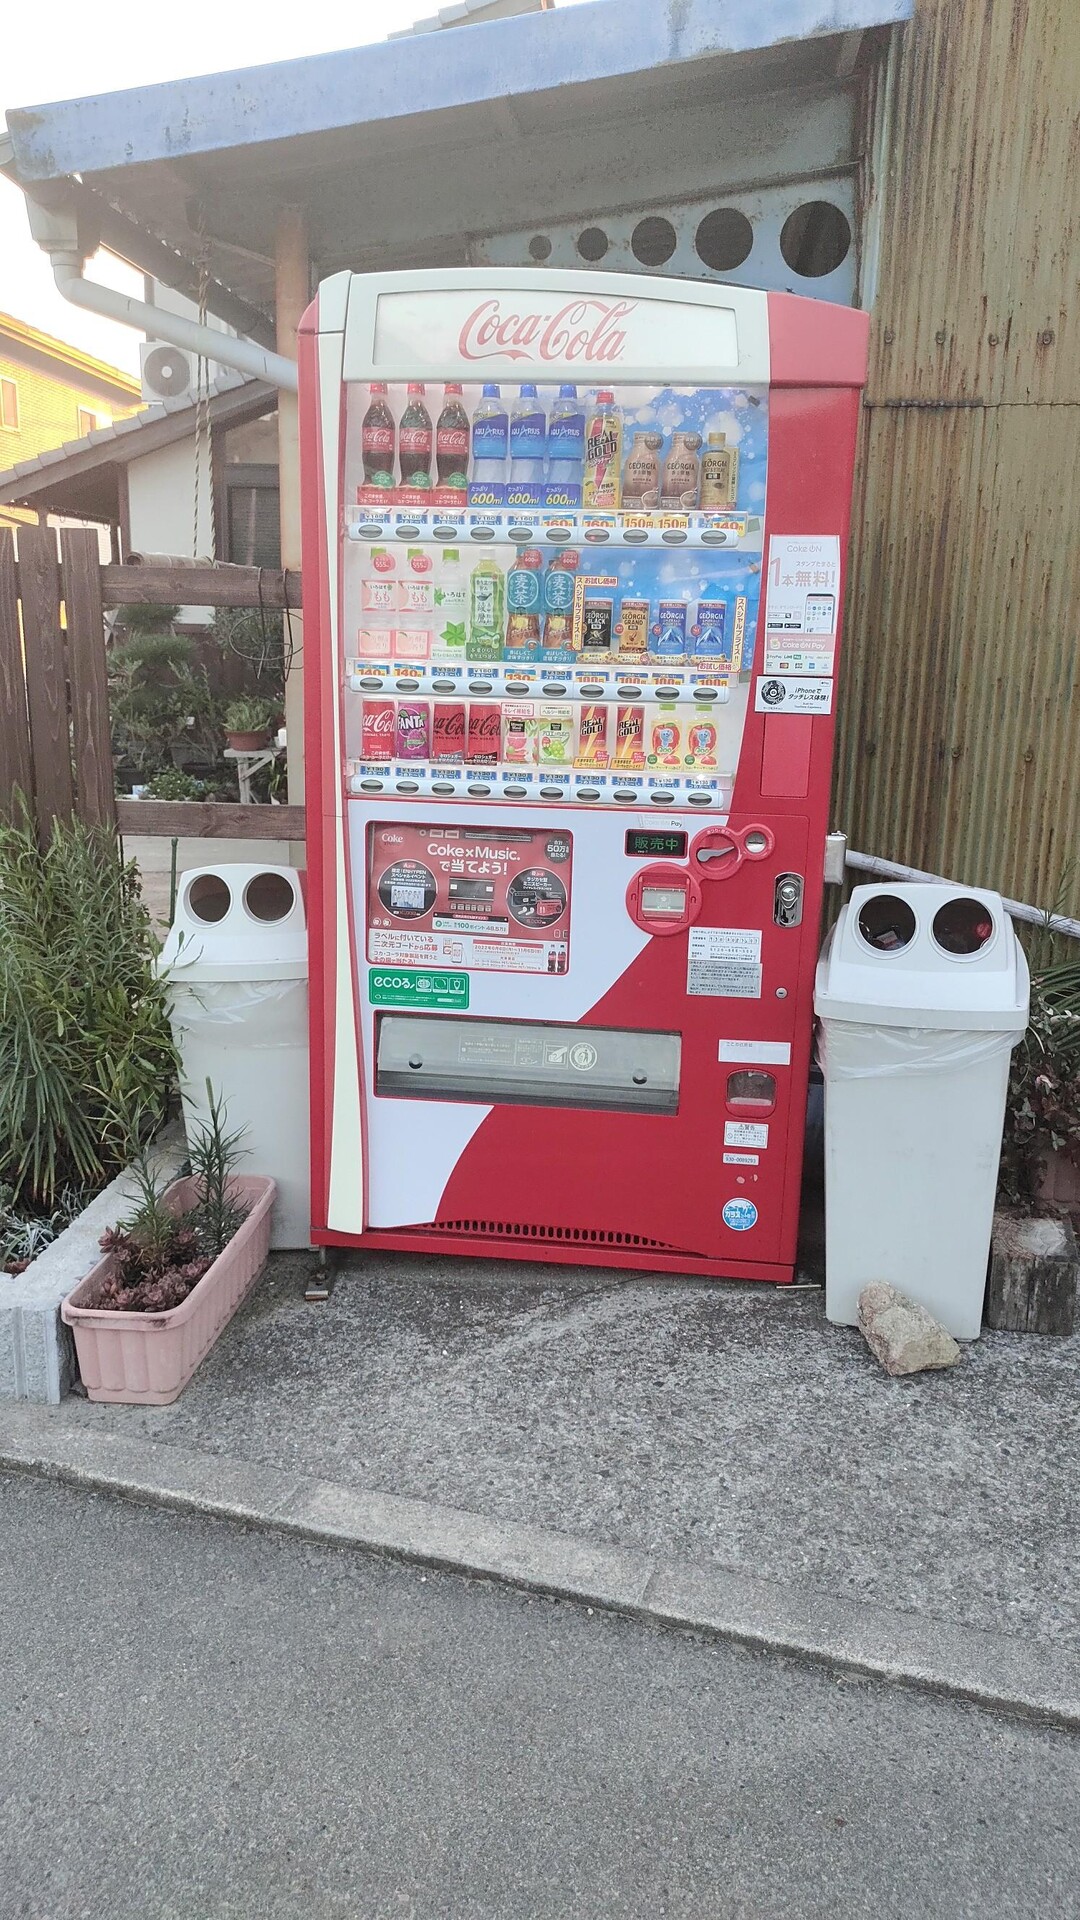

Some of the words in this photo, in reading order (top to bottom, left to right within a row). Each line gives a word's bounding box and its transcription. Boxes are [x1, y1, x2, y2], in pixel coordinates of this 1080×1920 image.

[458, 299, 638, 362] Coca-Cola
[474, 424, 505, 439] AQUARIUS
[511, 425, 540, 439] AQUARIUS
[550, 425, 580, 440] AQUARIUS
[588, 431, 616, 450] REAL
[587, 442, 617, 460] GOLD
[629, 462, 656, 470] GEORGIA
[667, 461, 695, 470] GEORGIA
[471, 493, 503, 506] 600ml
[508, 493, 540, 506] 600ml
[546, 494, 577, 506] 600ml
[584, 577, 617, 585] お試し価格
[514, 574, 528, 604] 麦茶
[552, 574, 567, 606] 麦茶
[374, 591, 390, 602] もも
[412, 592, 428, 603] もも
[585, 610, 610, 619] GEORGIA
[621, 611, 646, 620] GEORGIA
[660, 610, 684, 620] GEORGIA
[699, 610, 723, 620] GEORGIA
[811, 643, 826, 651] Pay
[581, 716, 603, 728] REAL
[619, 717, 640, 729] REAL
[581, 725, 603, 736] GOLD
[618, 726, 640, 737] GOLD
[670, 820, 683, 828] Pay
[381, 833, 404, 843] Coke
[634, 836, 679, 851] 販売中
[439, 859, 508, 876] で当てよう!
[374, 932, 434, 943] ラベルに付いている
[373, 940, 439, 951] 二次元コードから応募
